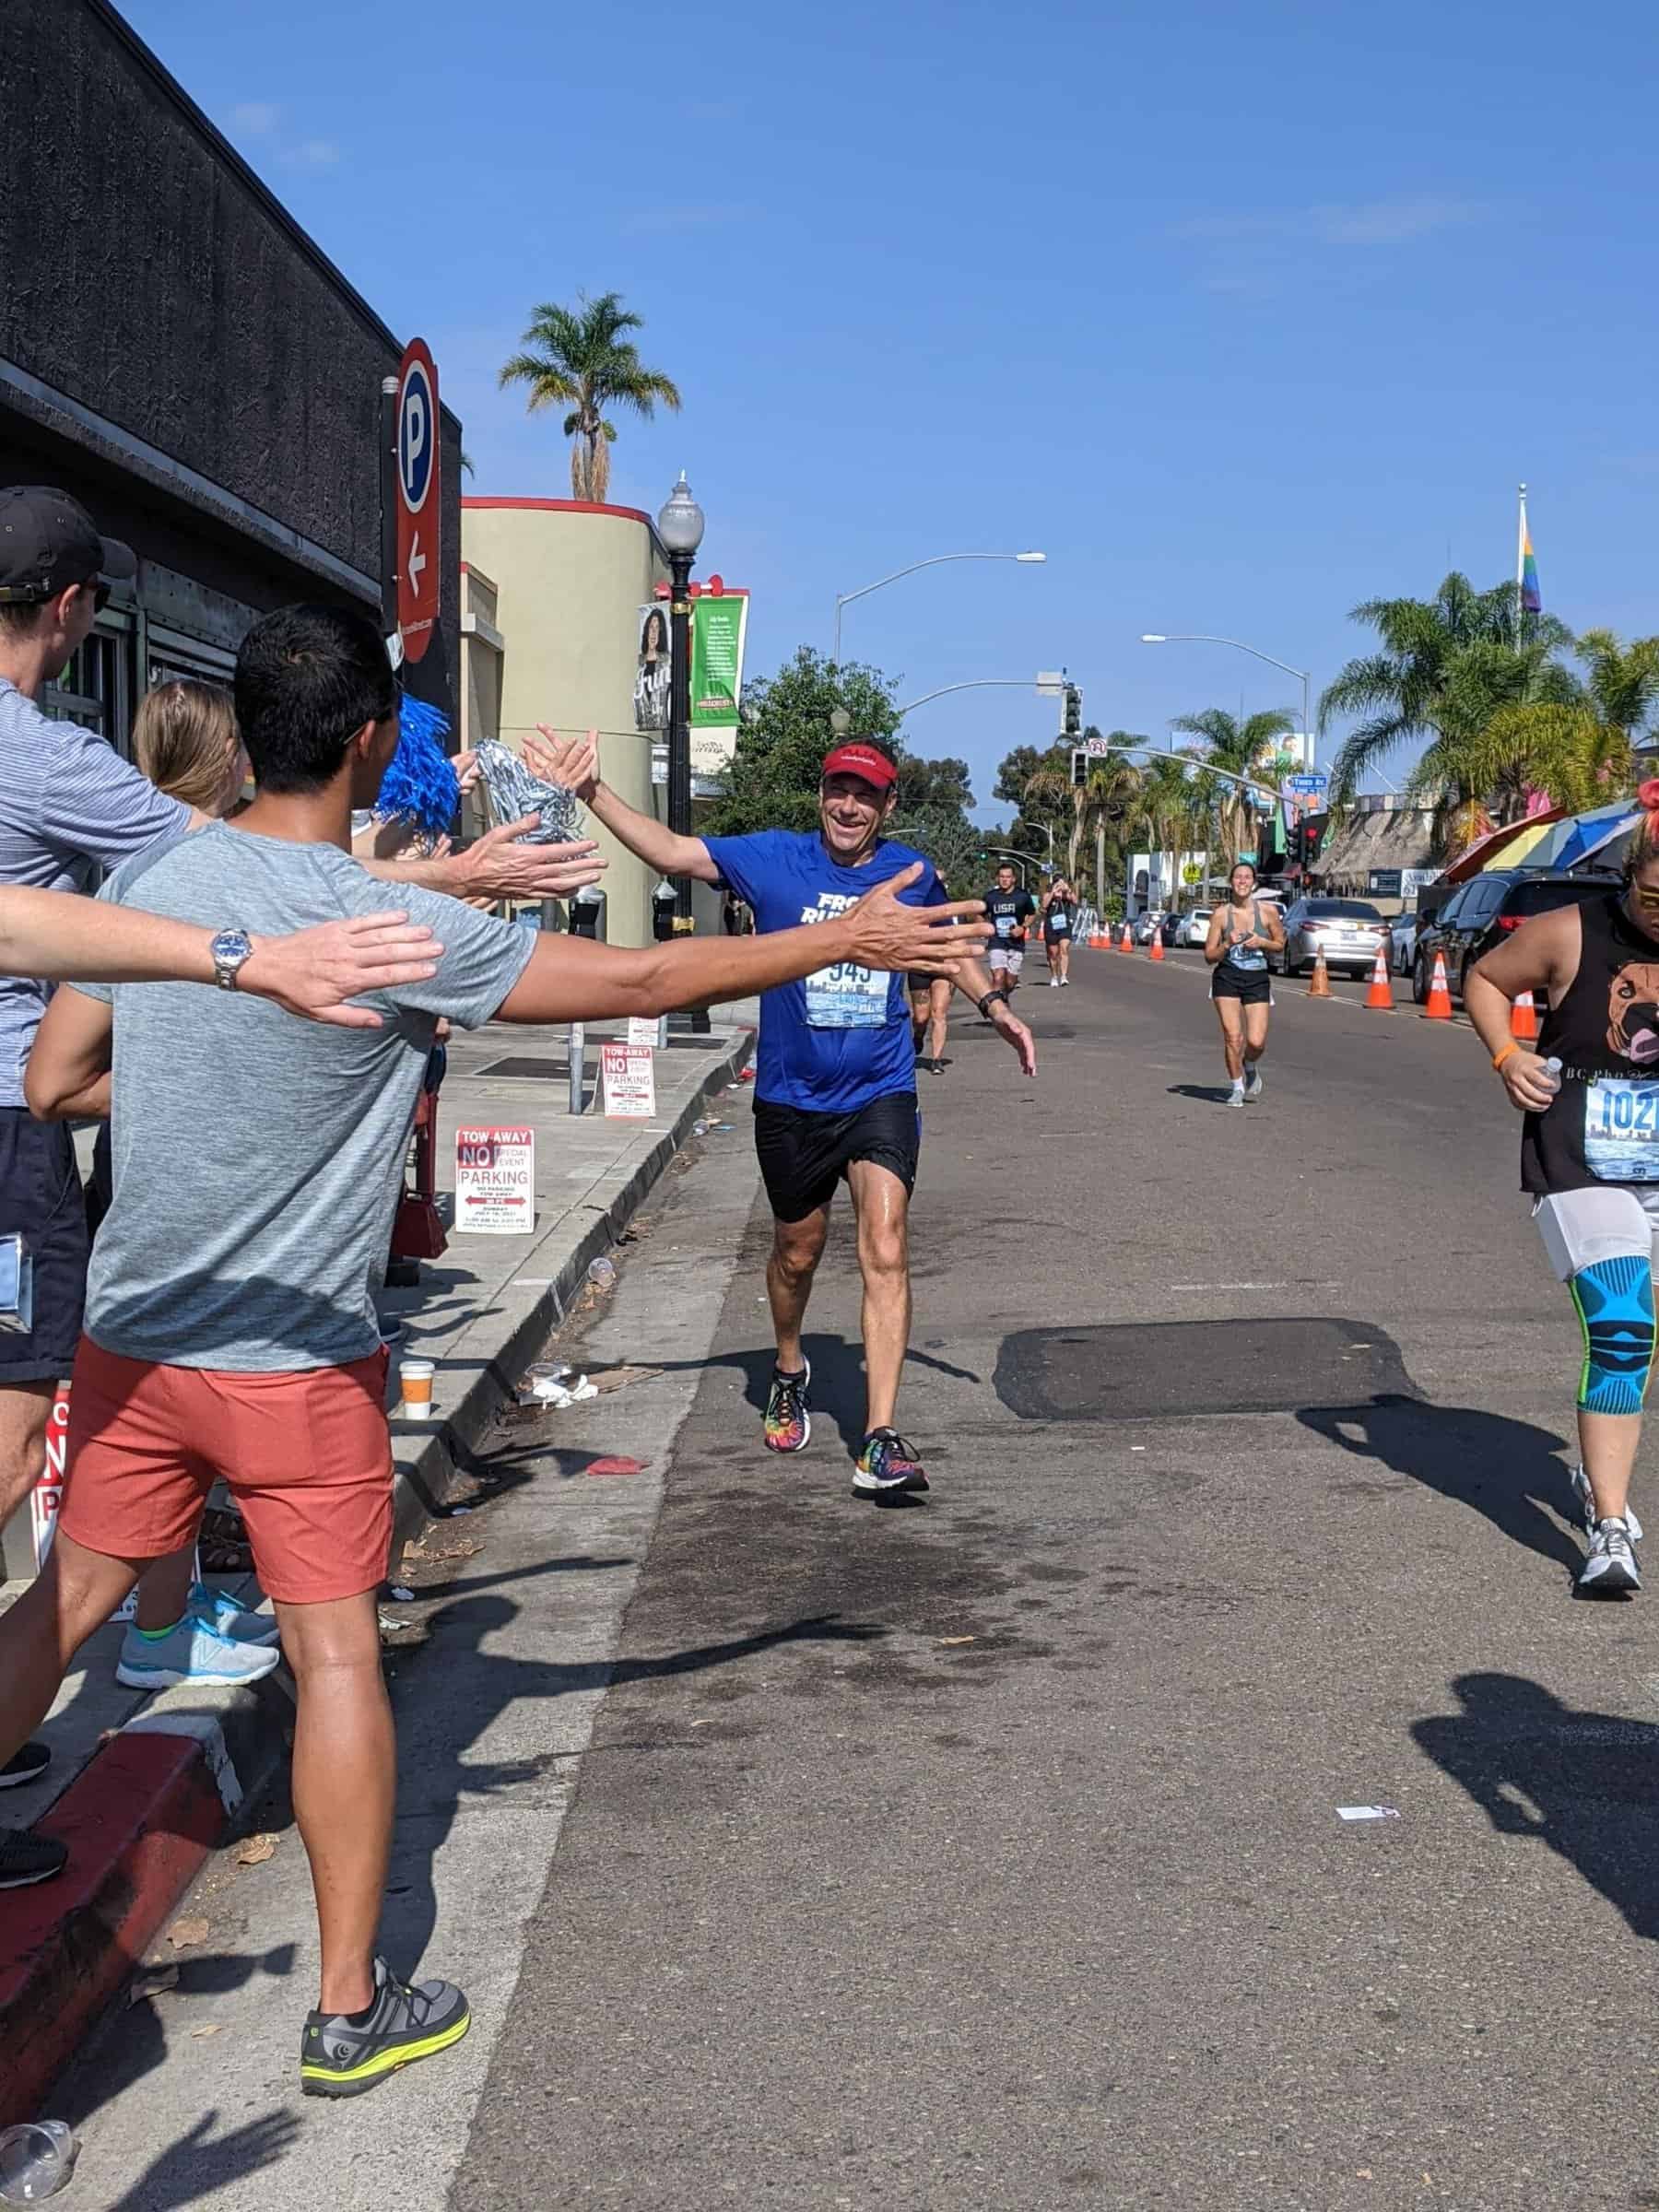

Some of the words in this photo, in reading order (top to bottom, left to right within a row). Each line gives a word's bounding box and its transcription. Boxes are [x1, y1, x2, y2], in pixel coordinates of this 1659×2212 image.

[406, 394, 424, 489] P
[993, 902, 1016, 914] USA
[607, 1048, 649, 1057] TOW-AWAY
[607, 1058, 626, 1073] NO
[606, 1076, 650, 1085] PARKING
[1603, 1090, 1659, 1130] 102
[462, 1131, 528, 1144] TOW-AWAY
[463, 1146, 490, 1167] NO
[461, 1171, 528, 1185] PARKING
